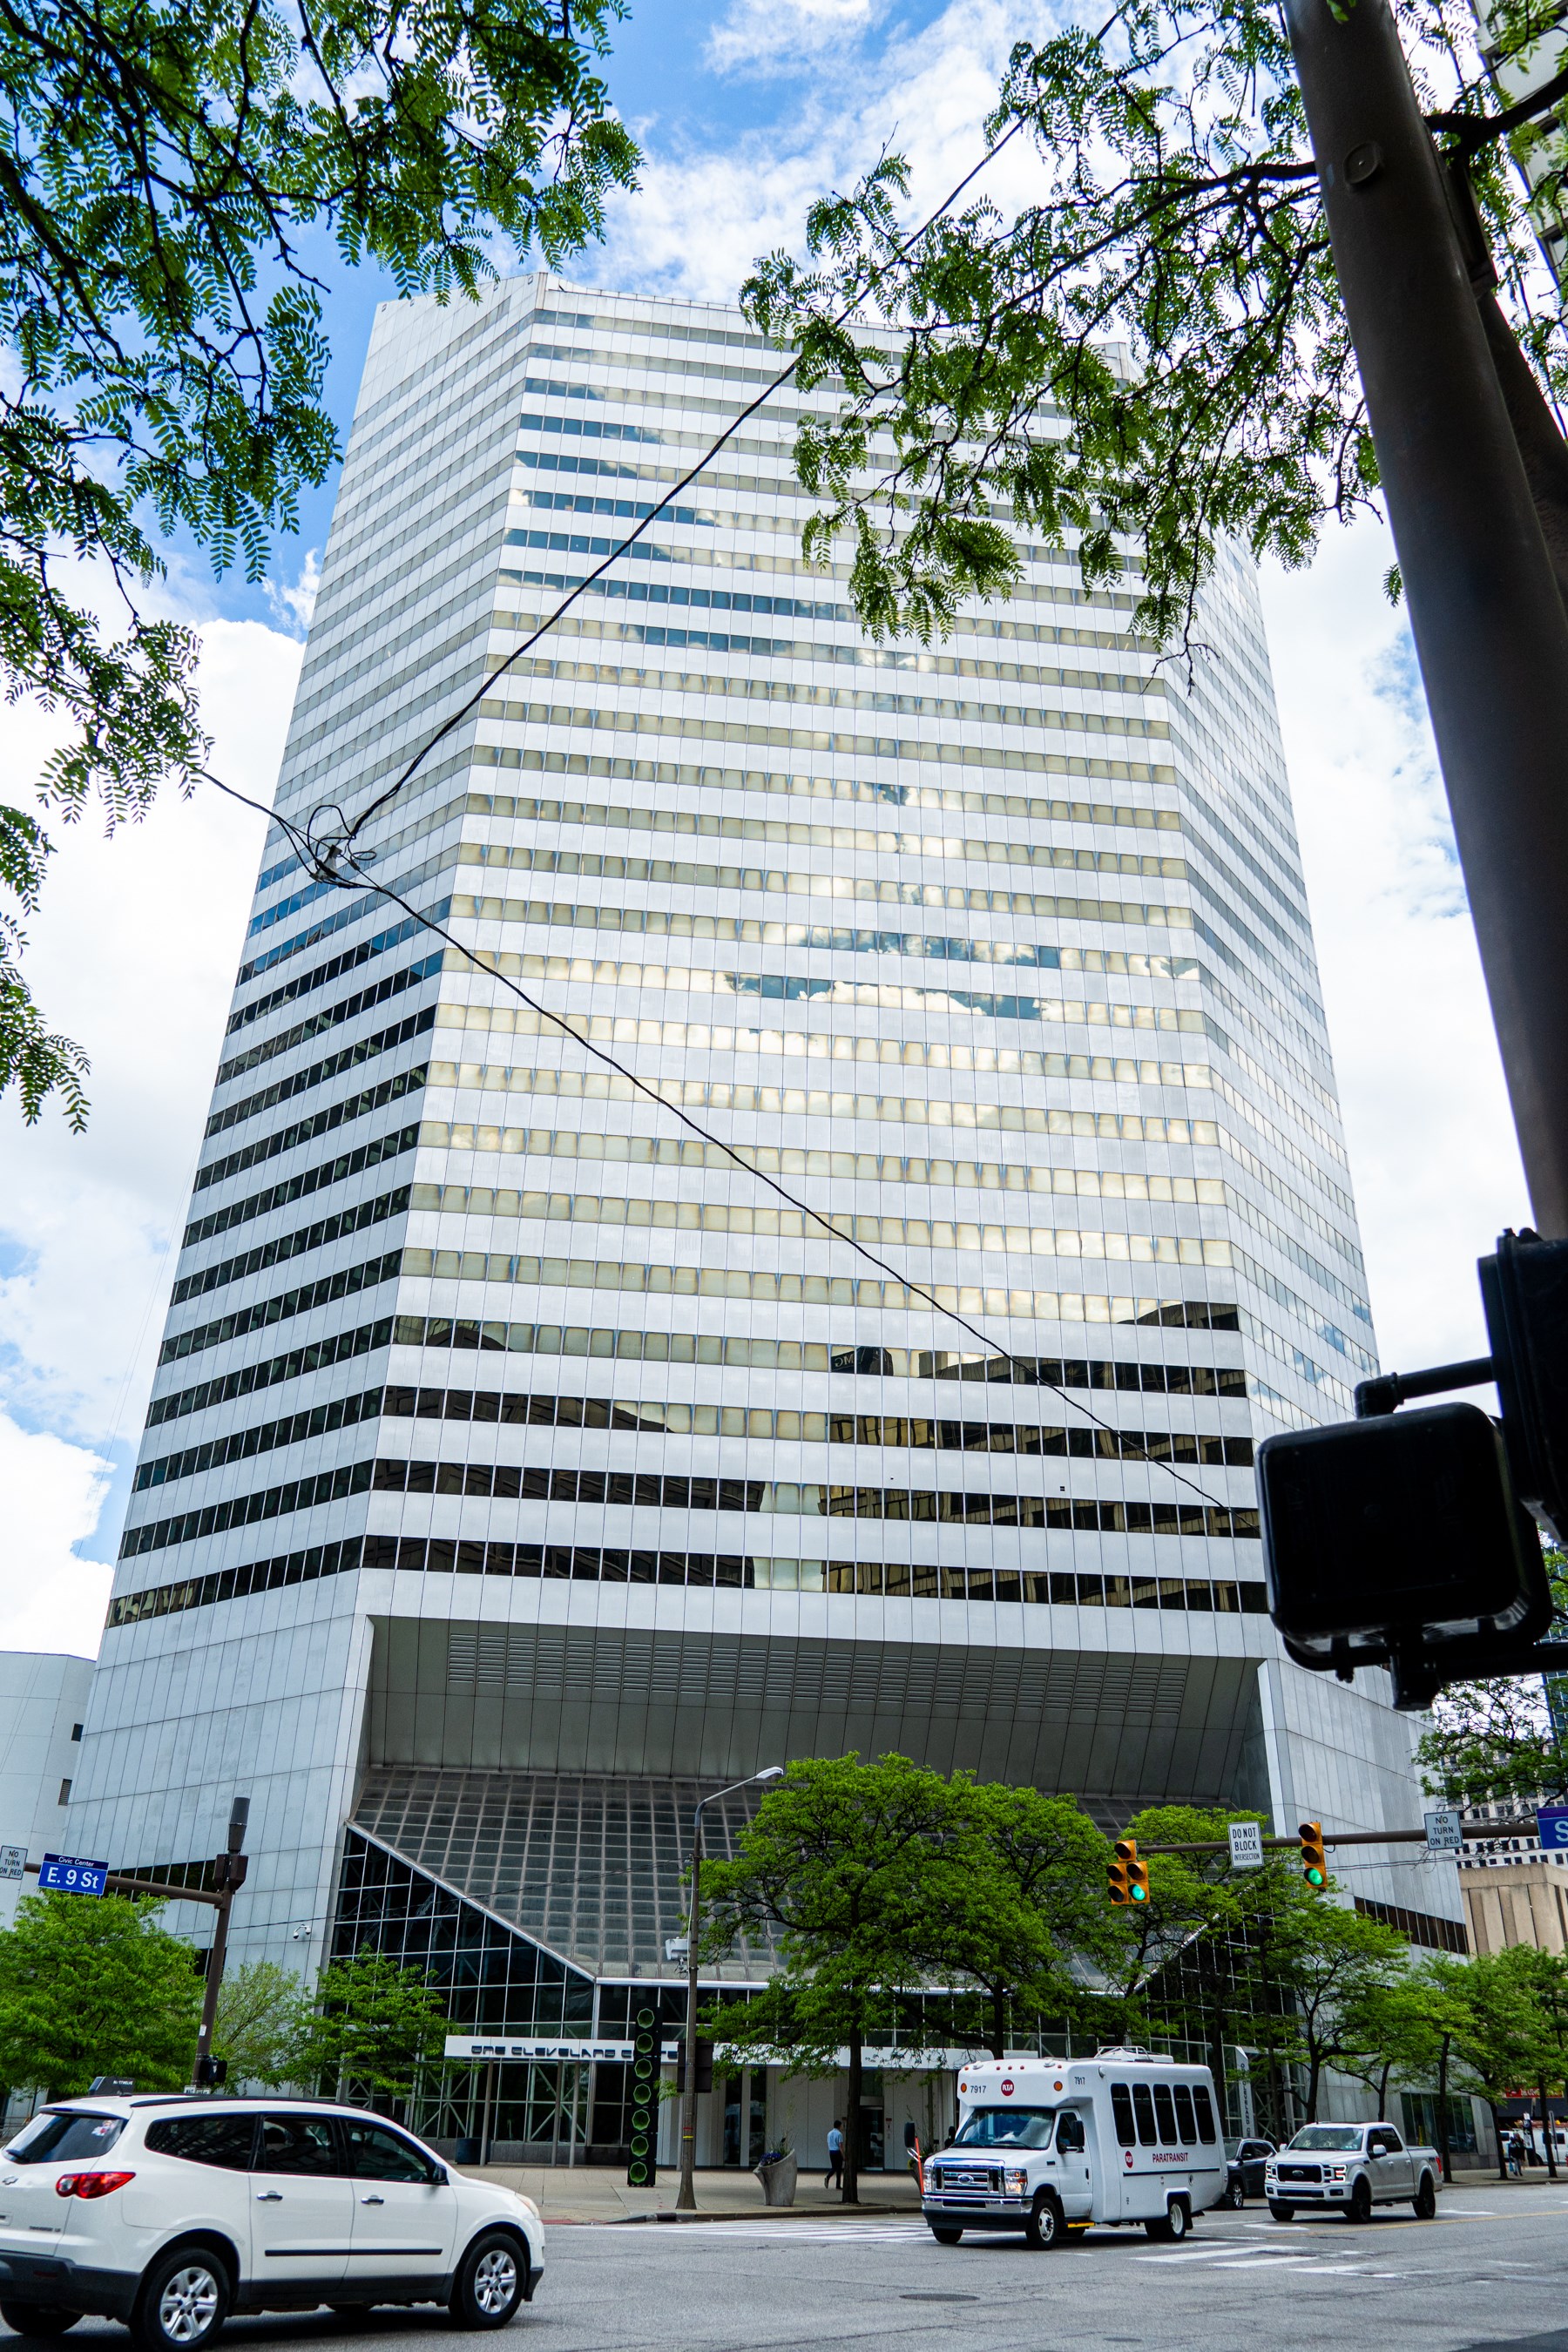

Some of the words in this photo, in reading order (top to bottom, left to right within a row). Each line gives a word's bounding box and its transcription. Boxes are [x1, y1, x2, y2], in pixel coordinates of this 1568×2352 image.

[1435, 1815, 1449, 1824] NO
[1233, 1828, 1241, 1838] DO
[1243, 1828, 1255, 1838] NOT
[1433, 1826, 1454, 1835] TURN
[1234, 1841, 1257, 1851] BLOCK
[1429, 1837, 1440, 1846] ON
[1443, 1836, 1459, 1846] RED
[4, 1858, 21, 1867] TURN
[74, 1858, 95, 1868] Center
[10, 1868, 22, 1876] RED
[47, 1866, 61, 1883] E.
[65, 1869, 78, 1886] 9
[80, 1871, 99, 1889] St
[471, 2045, 505, 2055] ONE
[511, 2046, 616, 2058] CLEVELAND
[1074, 2076, 1085, 2085] 7917
[970, 2085, 987, 2093] 7917
[1152, 2153, 1188, 2163] PARATRANSIT
